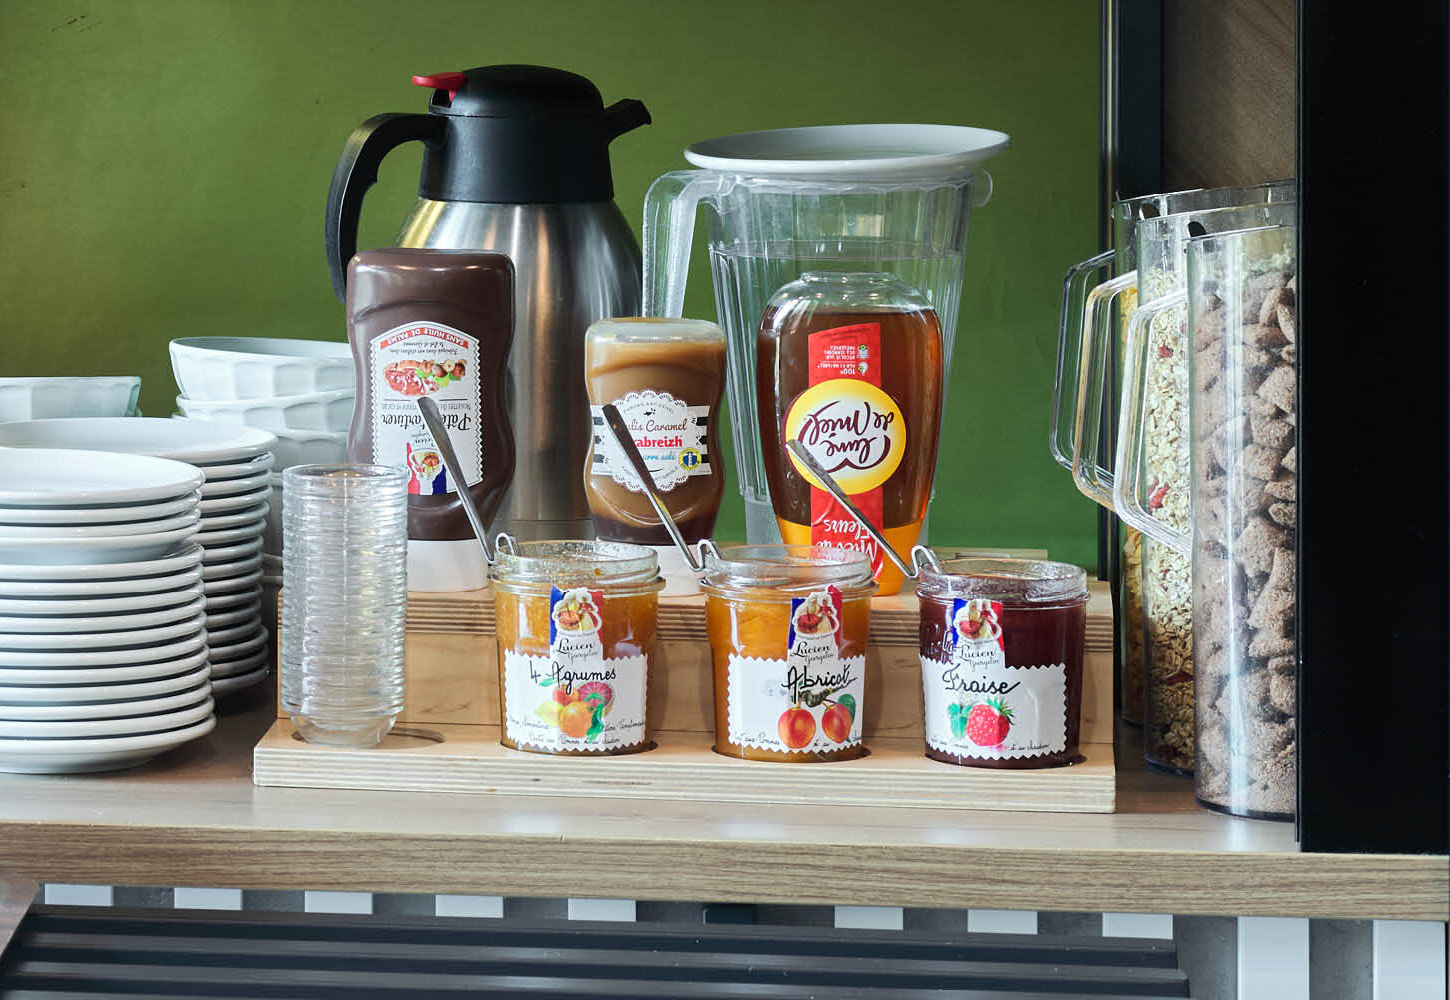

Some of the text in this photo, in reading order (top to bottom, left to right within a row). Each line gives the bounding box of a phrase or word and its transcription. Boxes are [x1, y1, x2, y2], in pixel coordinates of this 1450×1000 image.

[411, 328, 421, 336] DE
[425, 328, 445, 338] HUILE
[446, 334, 464, 345] SANS
[646, 418, 688, 432] Caramel
[790, 641, 830, 657] Lucien
[529, 660, 616, 695] 4 Agrumes
[781, 664, 857, 704] Abricot
[942, 663, 1021, 694] Fraise
